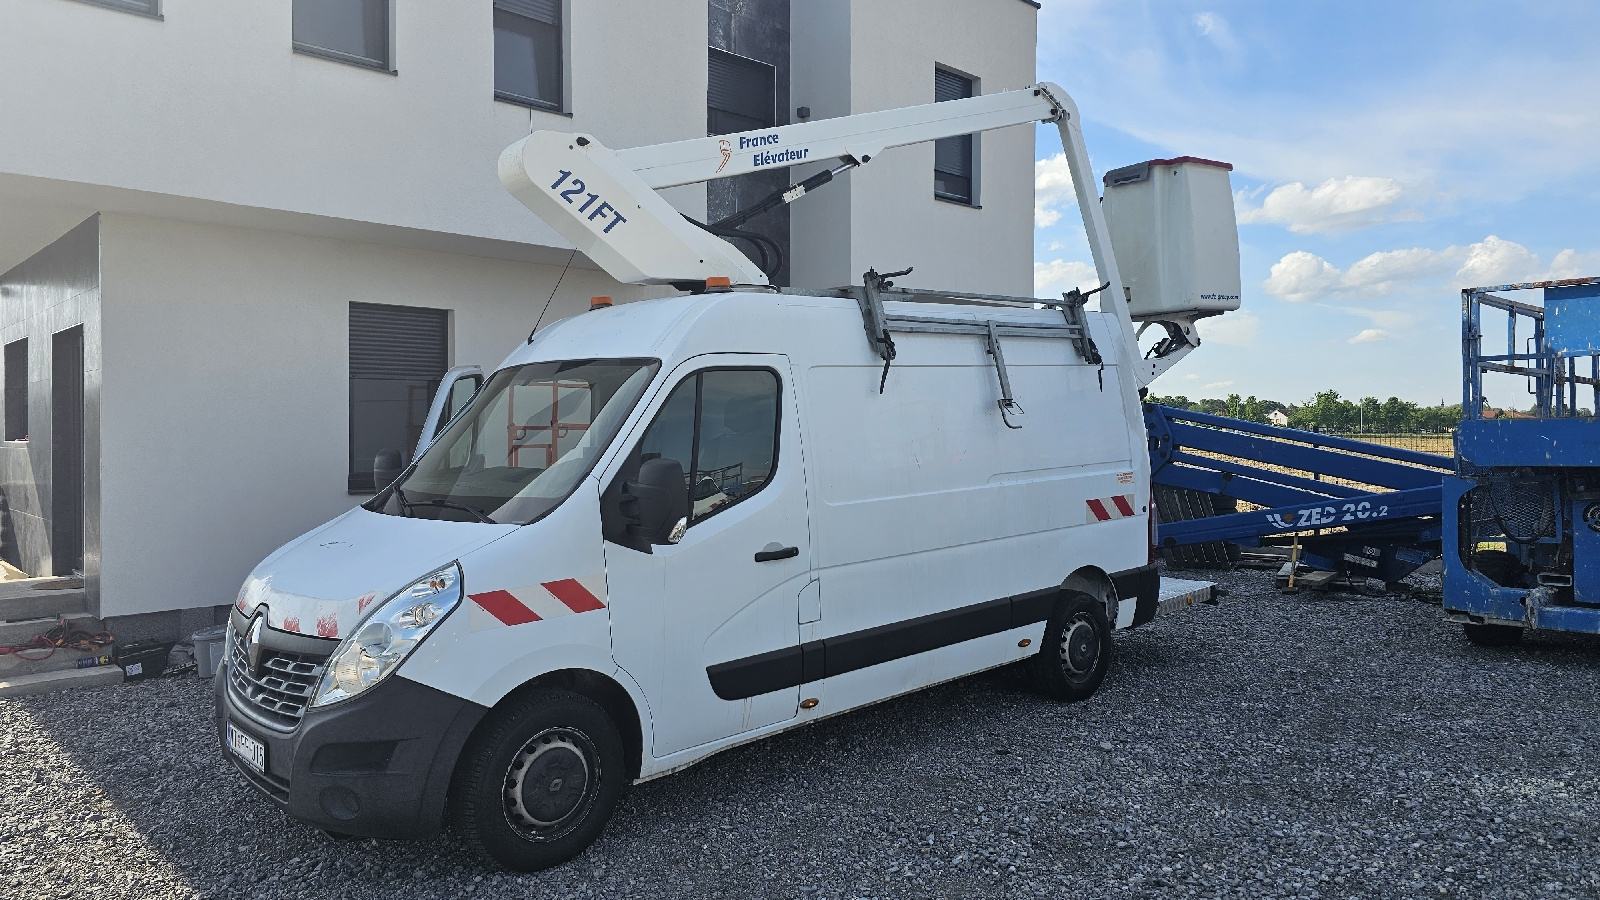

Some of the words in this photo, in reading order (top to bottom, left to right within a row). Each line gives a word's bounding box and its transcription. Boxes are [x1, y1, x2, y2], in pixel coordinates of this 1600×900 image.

[740, 134, 779, 149] France
[753, 148, 809, 167] Elévateur
[550, 169, 627, 234] 121FT
[1296, 506, 1337, 527] ZED
[1341, 501, 1389, 521] 20.2
